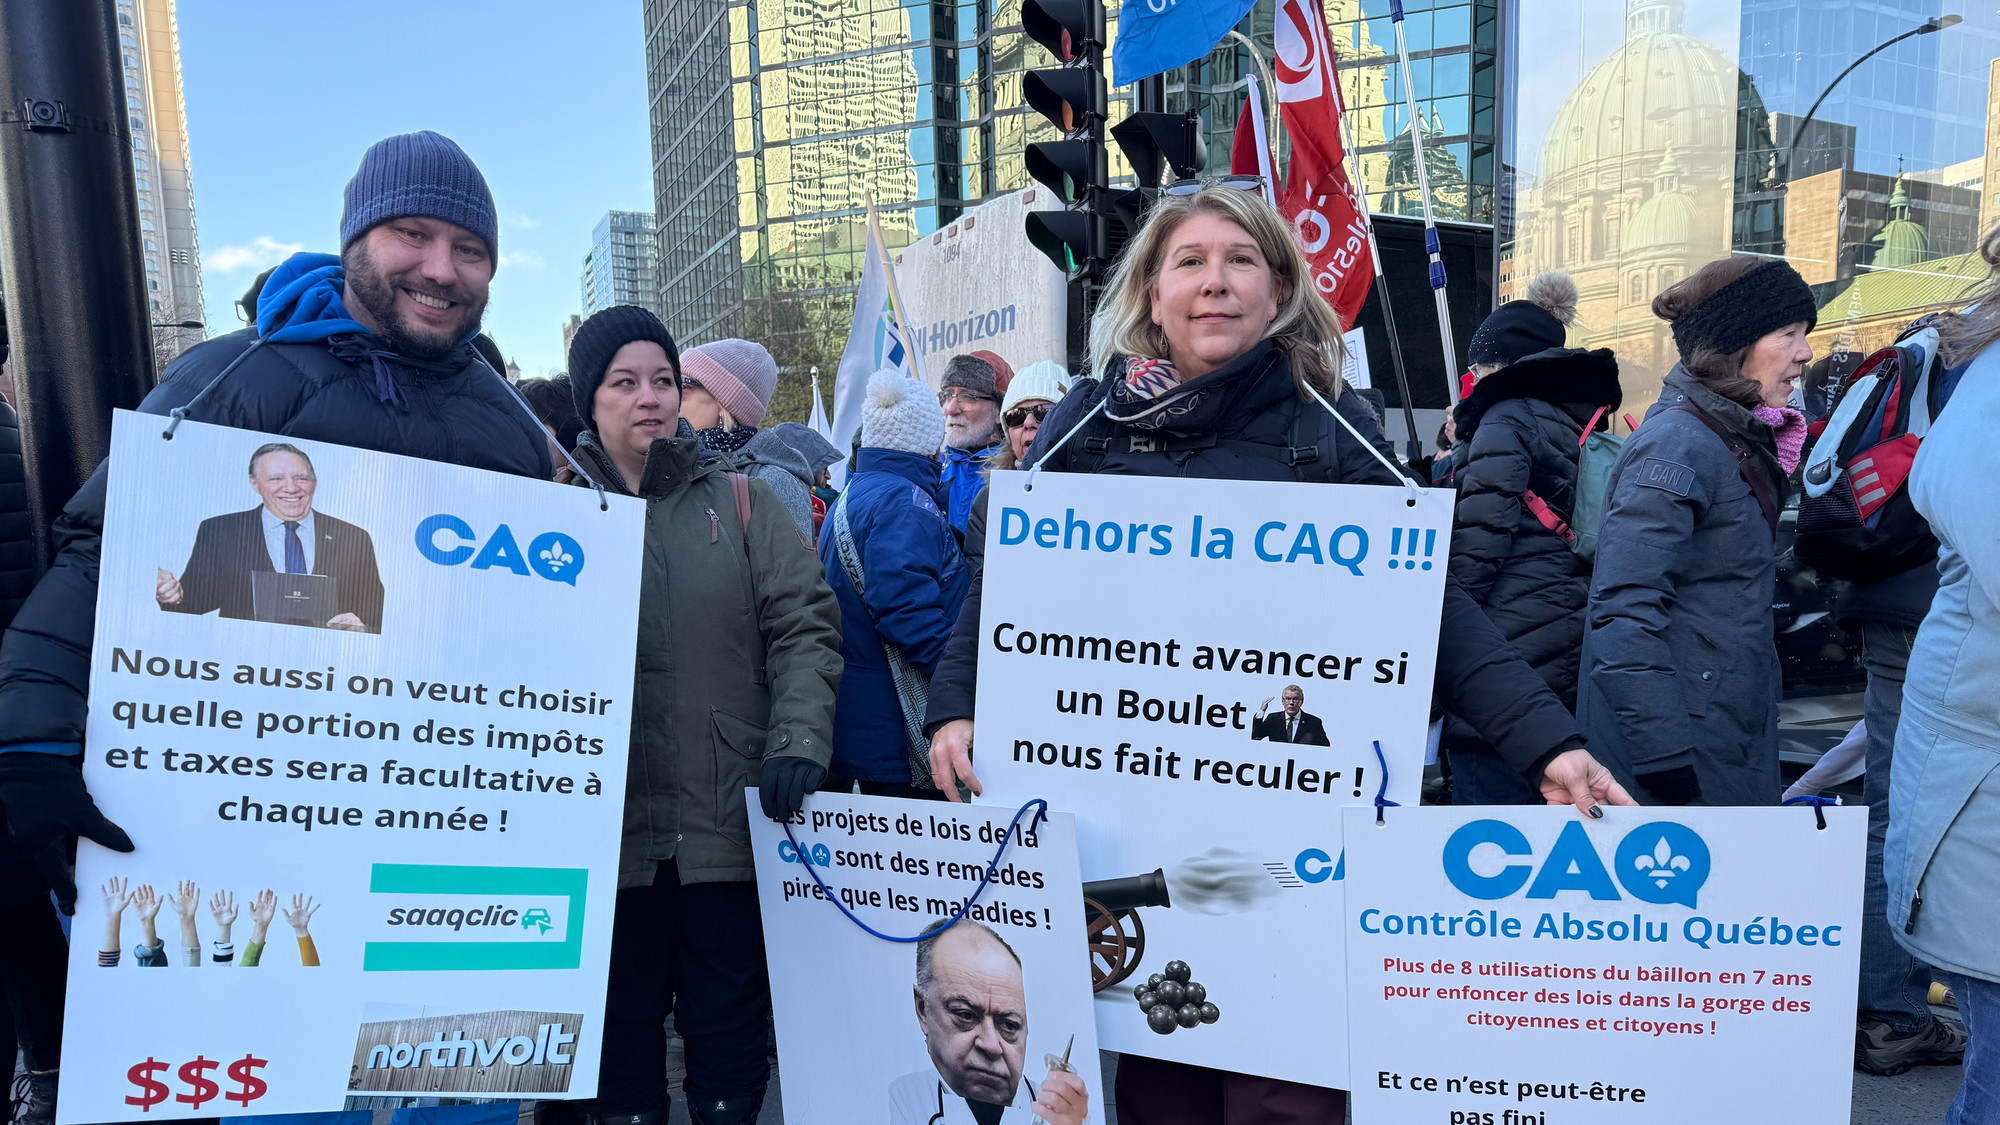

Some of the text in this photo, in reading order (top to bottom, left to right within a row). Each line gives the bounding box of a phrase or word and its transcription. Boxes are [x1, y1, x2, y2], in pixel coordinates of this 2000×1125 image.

[1650, 464, 1683, 486] CAN
[416, 514, 584, 586] CAQ
[1000, 507, 1436, 576] Dehors la CAQ !!!
[994, 623, 1408, 684] Comment avancer si
[112, 648, 612, 715] Nous aussi on veut choisir
[113, 701, 603, 757] quelle portion des impôts
[1057, 689, 1246, 729] un Boulet
[106, 747, 601, 795] et taxes sera facultative à
[1014, 740, 1363, 797] nous fait reculer !
[219, 796, 507, 832] chaque année !
[812, 809, 888, 836] projets
[896, 813, 922, 836] de
[930, 816, 971, 841] lois
[979, 821, 1008, 845] de
[1017, 824, 1039, 848] la
[778, 839, 1044, 889] CAQ sont des remèdes
[1443, 819, 1711, 909] CAQ
[387, 905, 518, 931] saaqclic
[782, 877, 1050, 930] pires que les maladies !
[1360, 909, 1842, 949] Contrôle Absolu Québec
[1384, 958, 1811, 986] Plus de 8 utilisations du bâillon en 7 ans
[1385, 986, 1810, 1014] pour enfoncer des lois dans la gorge des
[367, 1023, 577, 1070] northvolt
[1468, 1013, 1715, 1036] citoyennes et citoyens !
[125, 1054, 268, 1112] $$$
[1379, 1072, 1402, 1089] Et
[1410, 1077, 1437, 1091] ce
[1518, 1082, 1645, 1102] peut-être
[1450, 1109, 1545, 1125] pas fini
